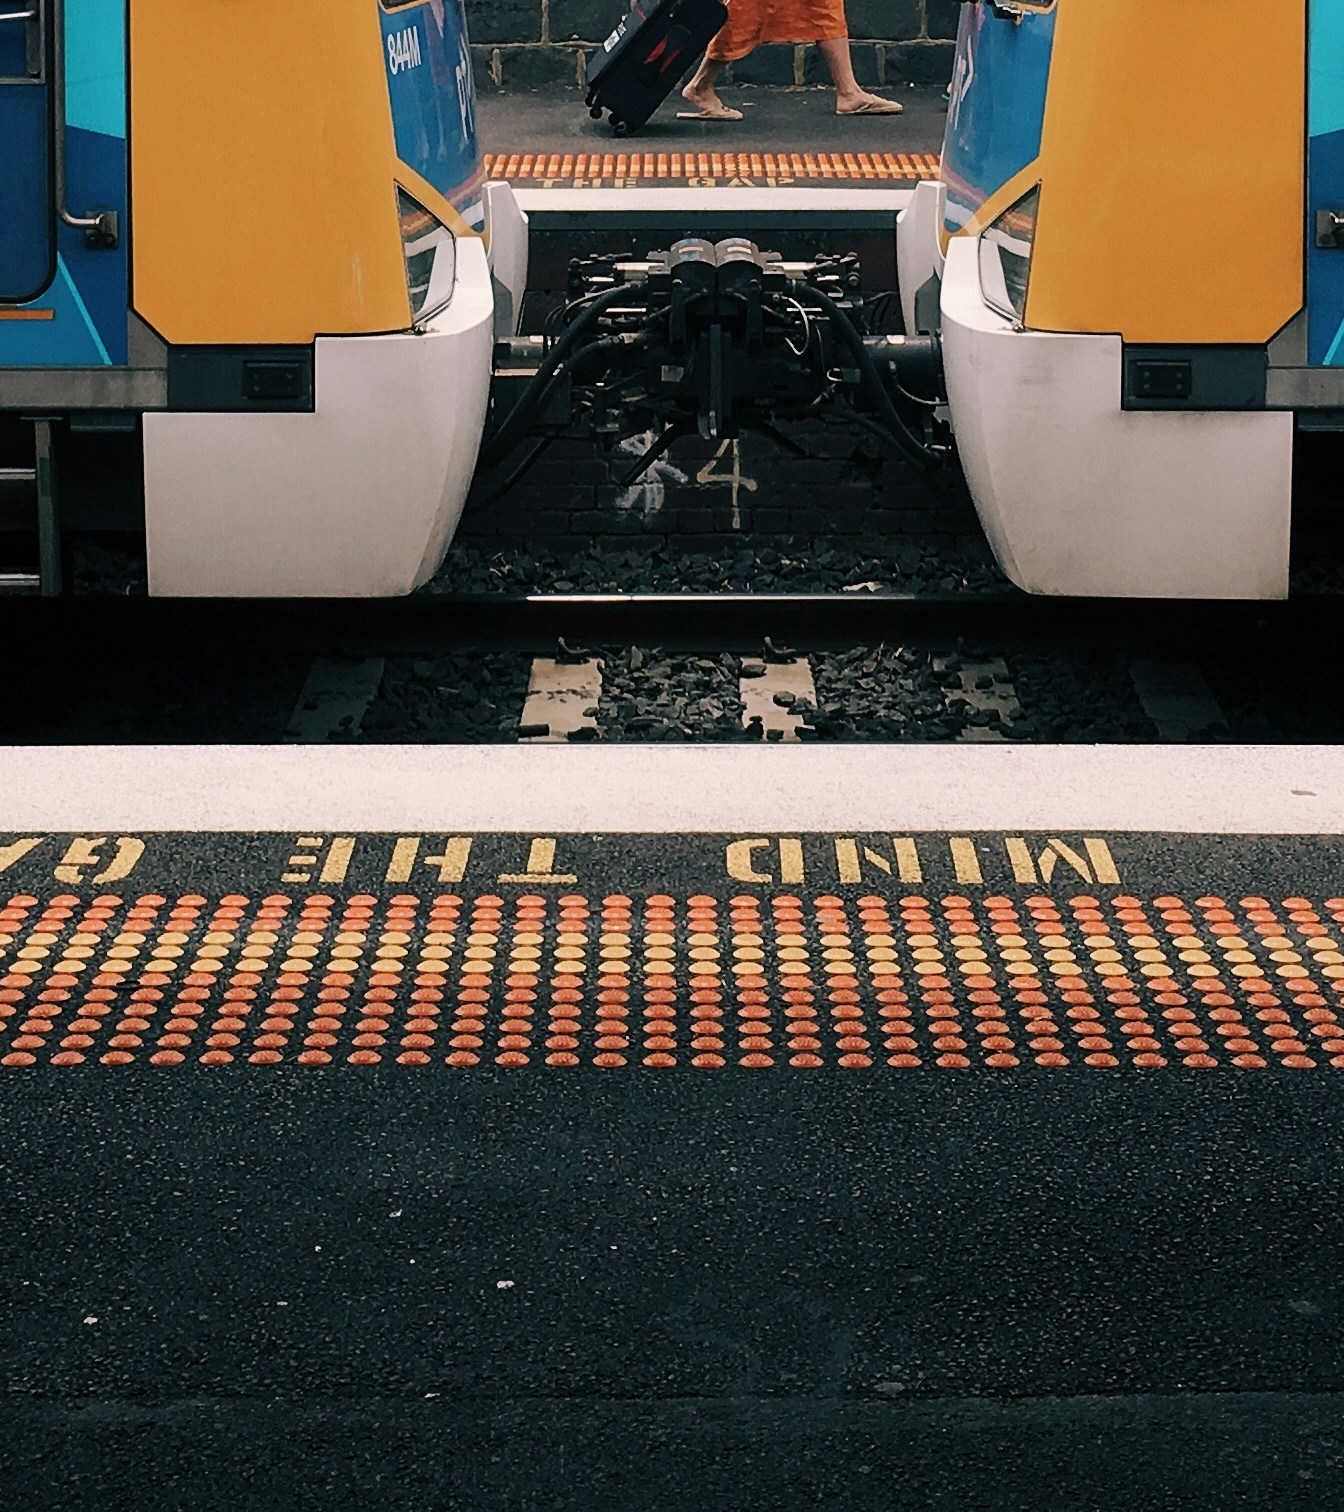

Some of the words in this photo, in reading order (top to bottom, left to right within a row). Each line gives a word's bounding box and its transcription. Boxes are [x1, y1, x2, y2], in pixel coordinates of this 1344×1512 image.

[387, 25, 422, 76] 844M
[536, 177, 638, 188] THE
[688, 177, 795, 188] GAP
[280, 836, 578, 885] THE
[725, 837, 1122, 885] MIND
